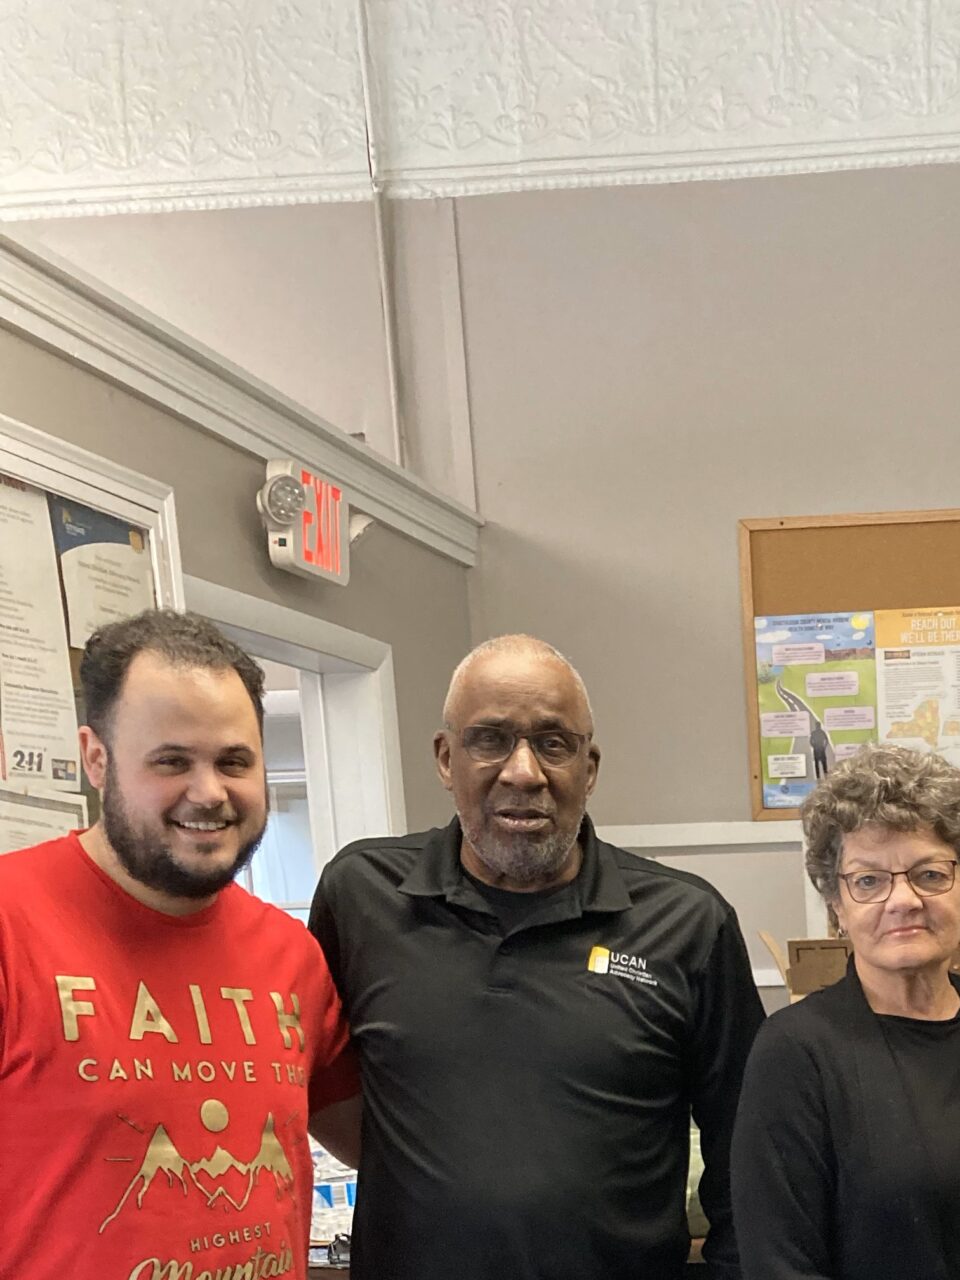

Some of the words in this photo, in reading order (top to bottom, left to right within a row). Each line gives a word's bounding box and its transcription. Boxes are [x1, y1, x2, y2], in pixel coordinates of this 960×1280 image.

[301, 469, 343, 577] EXIT
[911, 618, 938, 631] REACH
[928, 630, 938, 642] BE
[610, 952, 647, 970] UCAN
[55, 974, 306, 1052] FAITH
[77, 1058, 154, 1082] CAN
[172, 1060, 257, 1083] MOVE
[270, 1062, 306, 1087] THE
[190, 1222, 272, 1253] HIGHEST
